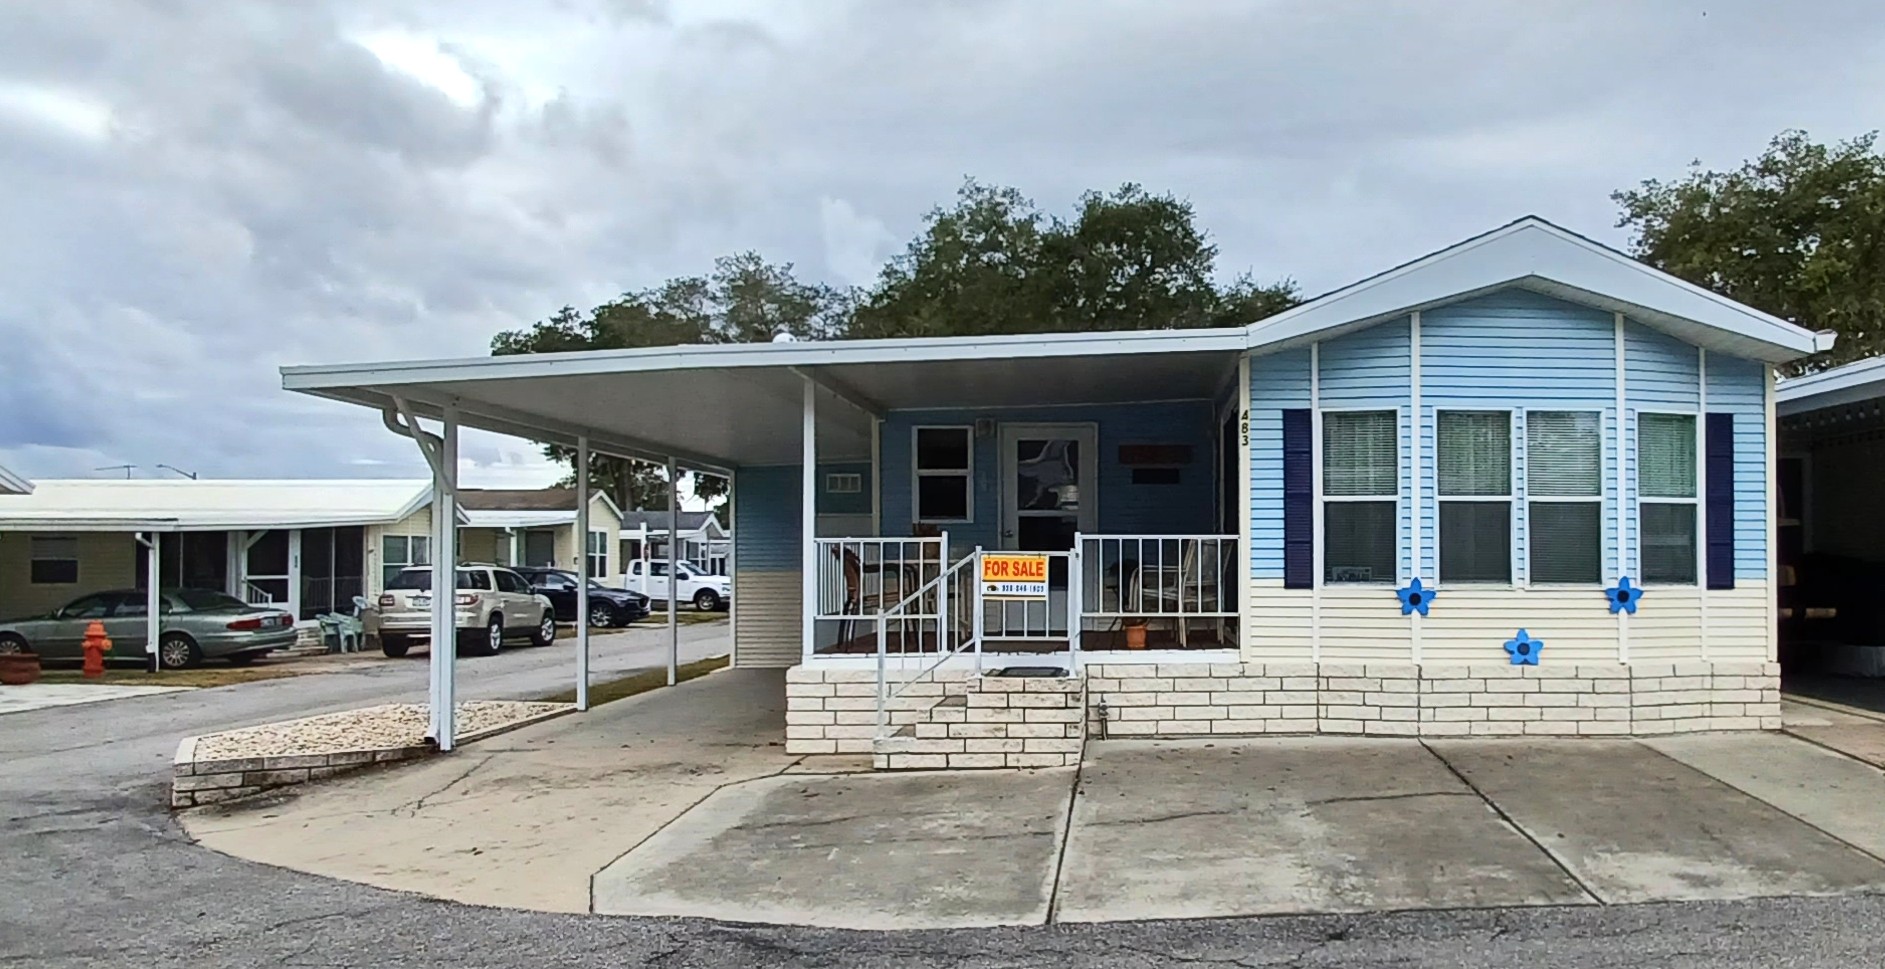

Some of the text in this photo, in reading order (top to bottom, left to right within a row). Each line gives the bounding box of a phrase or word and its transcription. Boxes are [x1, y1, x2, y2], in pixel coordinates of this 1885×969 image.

[1241, 409, 1249, 446] 483
[984, 560, 1045, 577] FOR SALE
